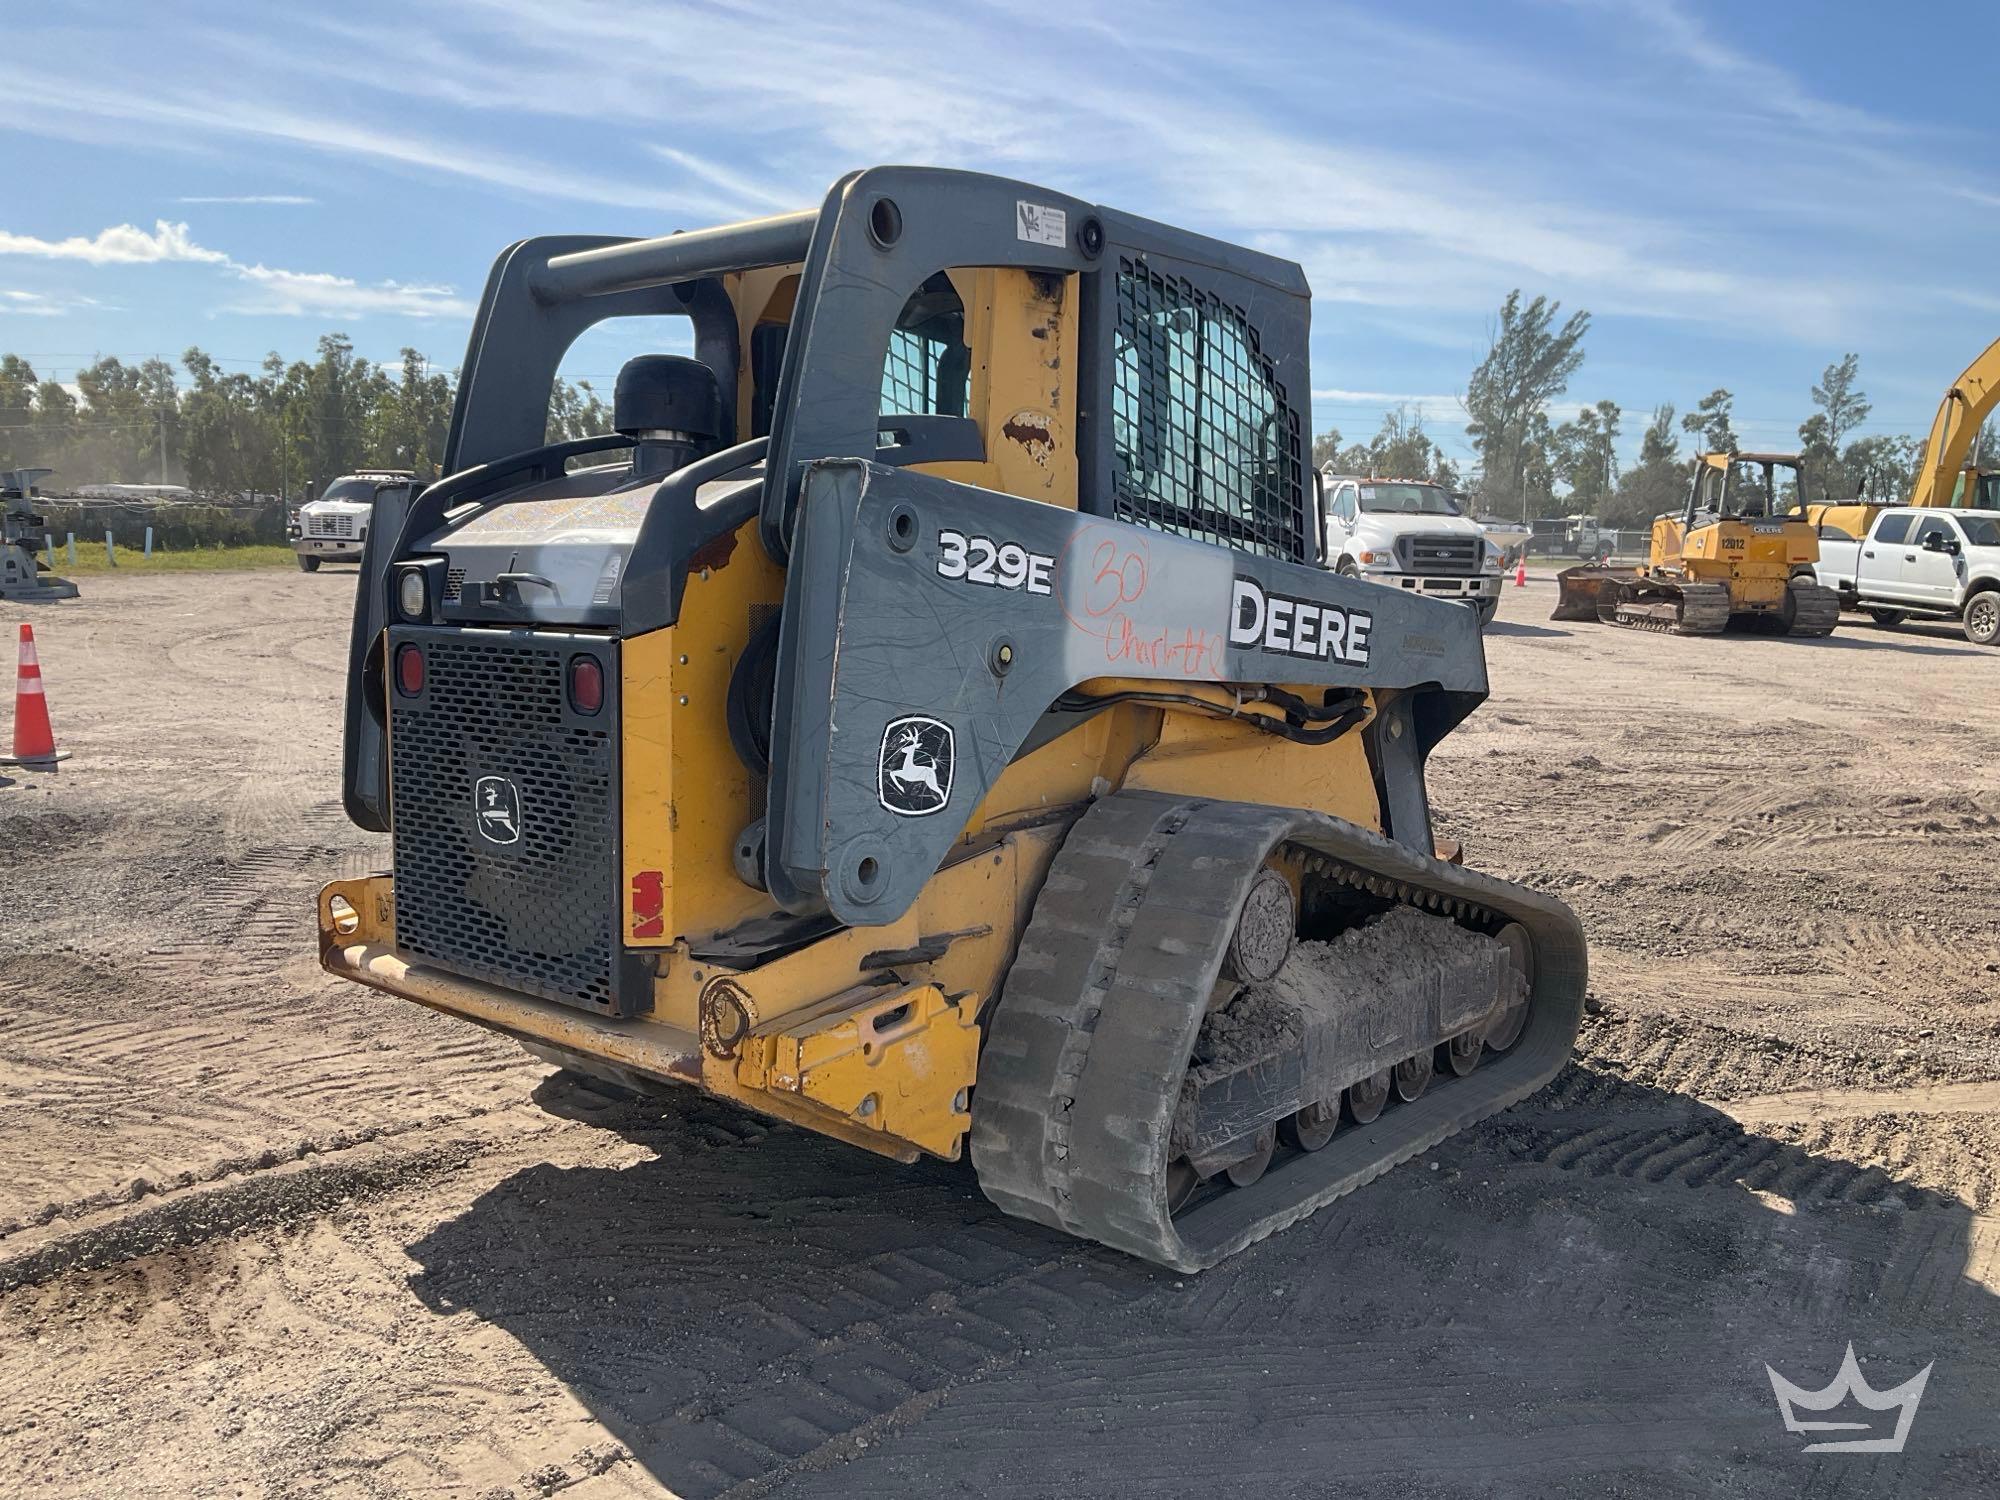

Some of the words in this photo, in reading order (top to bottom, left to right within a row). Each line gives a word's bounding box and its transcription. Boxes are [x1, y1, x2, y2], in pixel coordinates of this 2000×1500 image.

[937, 530, 1055, 596] 329E
[1753, 526, 1784, 534] DEERE
[1085, 540, 1146, 617] 30
[1228, 577, 1373, 665] DEERE
